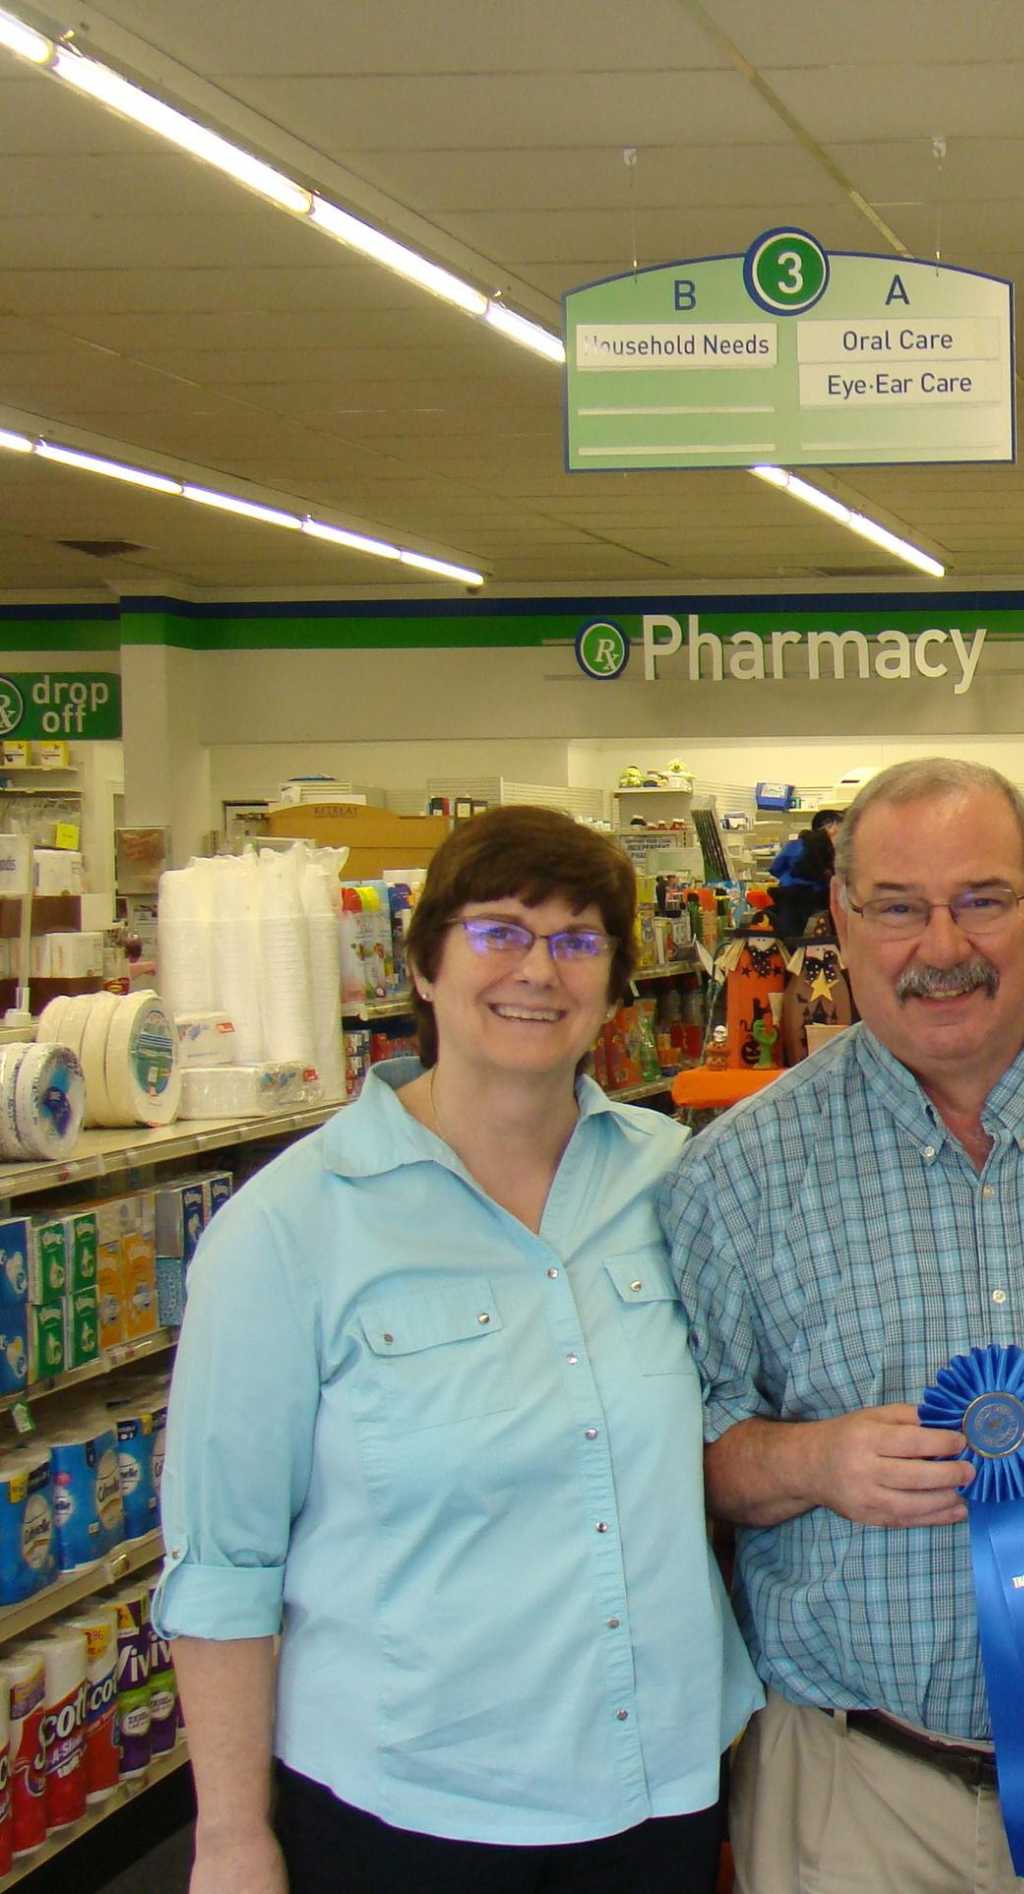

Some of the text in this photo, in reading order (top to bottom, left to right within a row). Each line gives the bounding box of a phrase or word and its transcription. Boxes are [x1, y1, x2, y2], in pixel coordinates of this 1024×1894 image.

[777, 252, 803, 294] 3
[674, 280, 697, 311] B
[885, 275, 910, 305] A
[703, 334, 769, 355] Needs
[843, 329, 953, 352] Oral Care
[920, 372, 972, 394] Care
[642, 614, 987, 694] Pharmacy
[32, 675, 109, 712] drop
[42, 704, 87, 733] off
